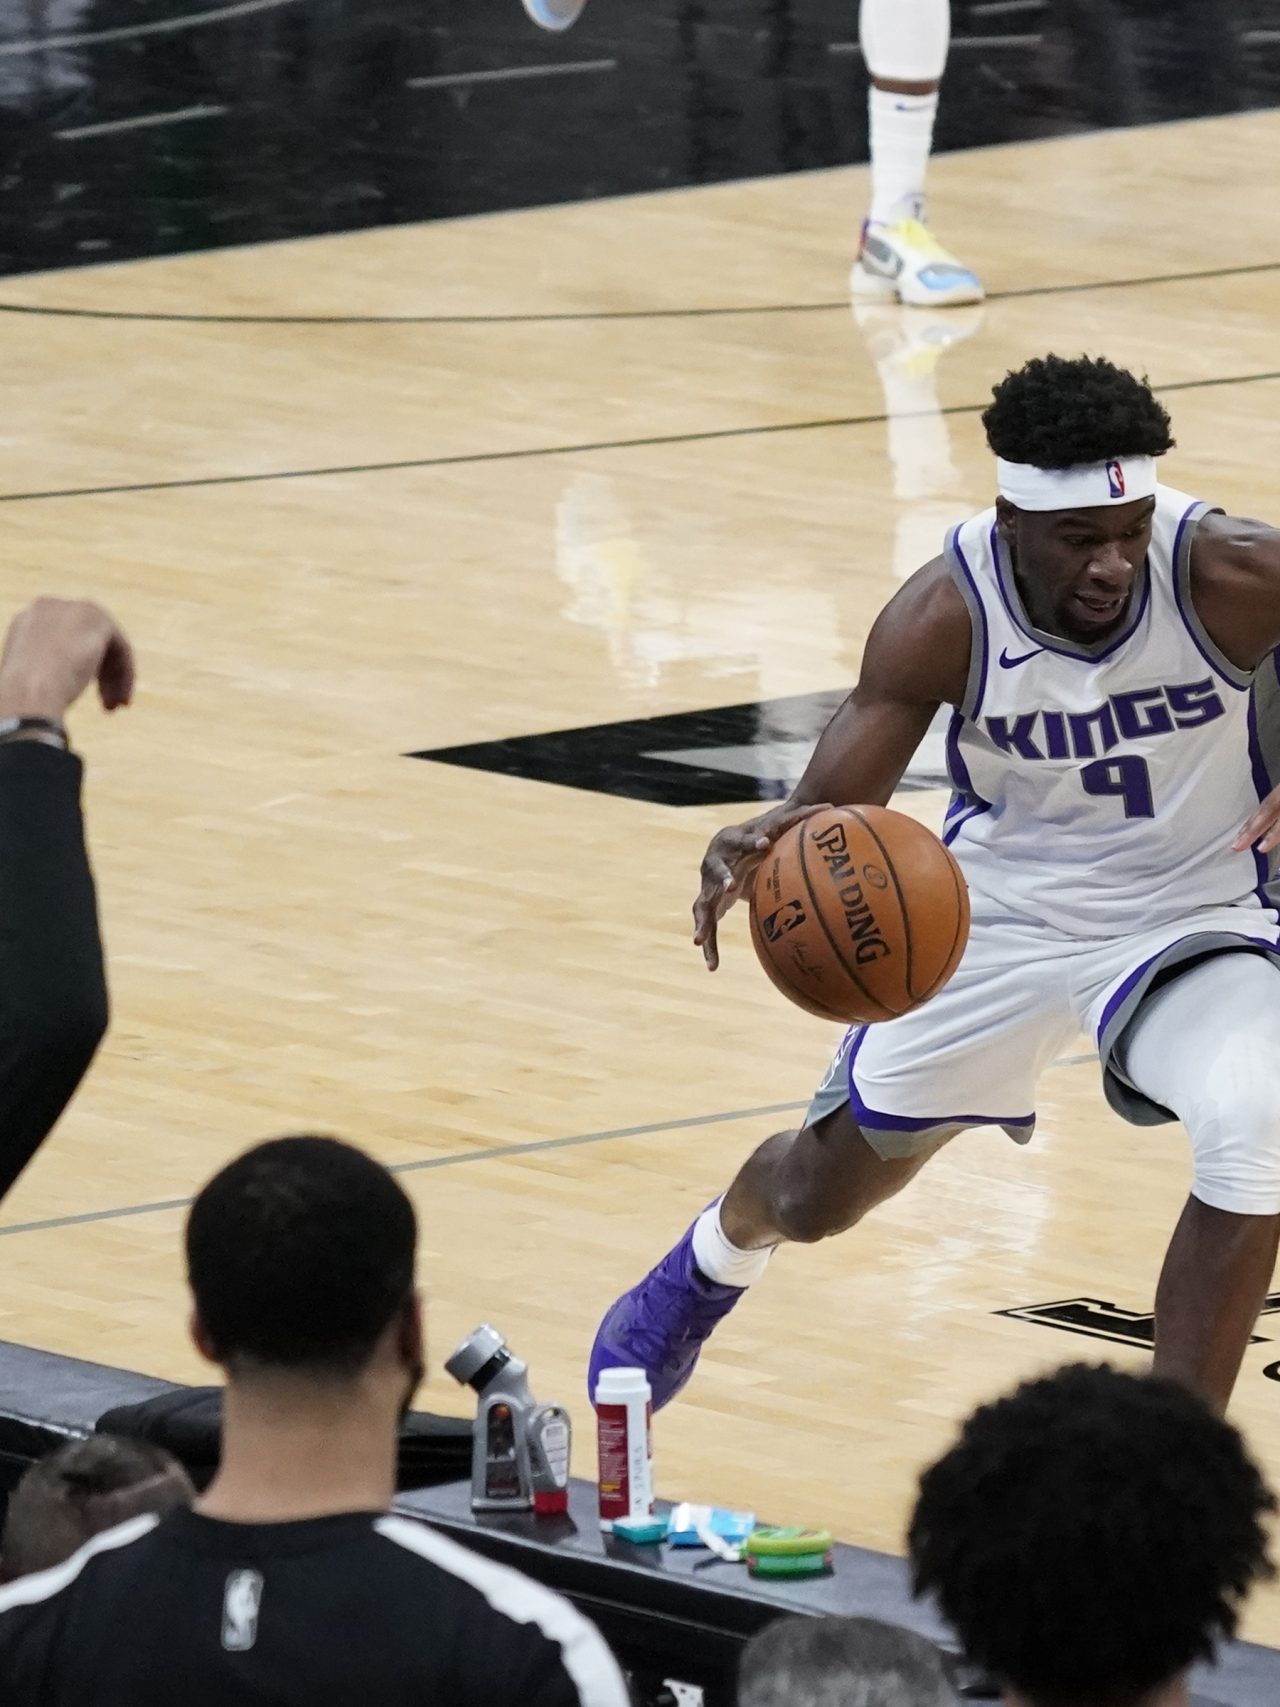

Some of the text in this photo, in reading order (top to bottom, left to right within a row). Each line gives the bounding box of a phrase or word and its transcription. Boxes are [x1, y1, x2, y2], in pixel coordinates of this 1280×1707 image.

[984, 675, 1227, 761] KINGS
[1079, 753, 1156, 820] 9
[811, 822, 892, 966] SPALDING
